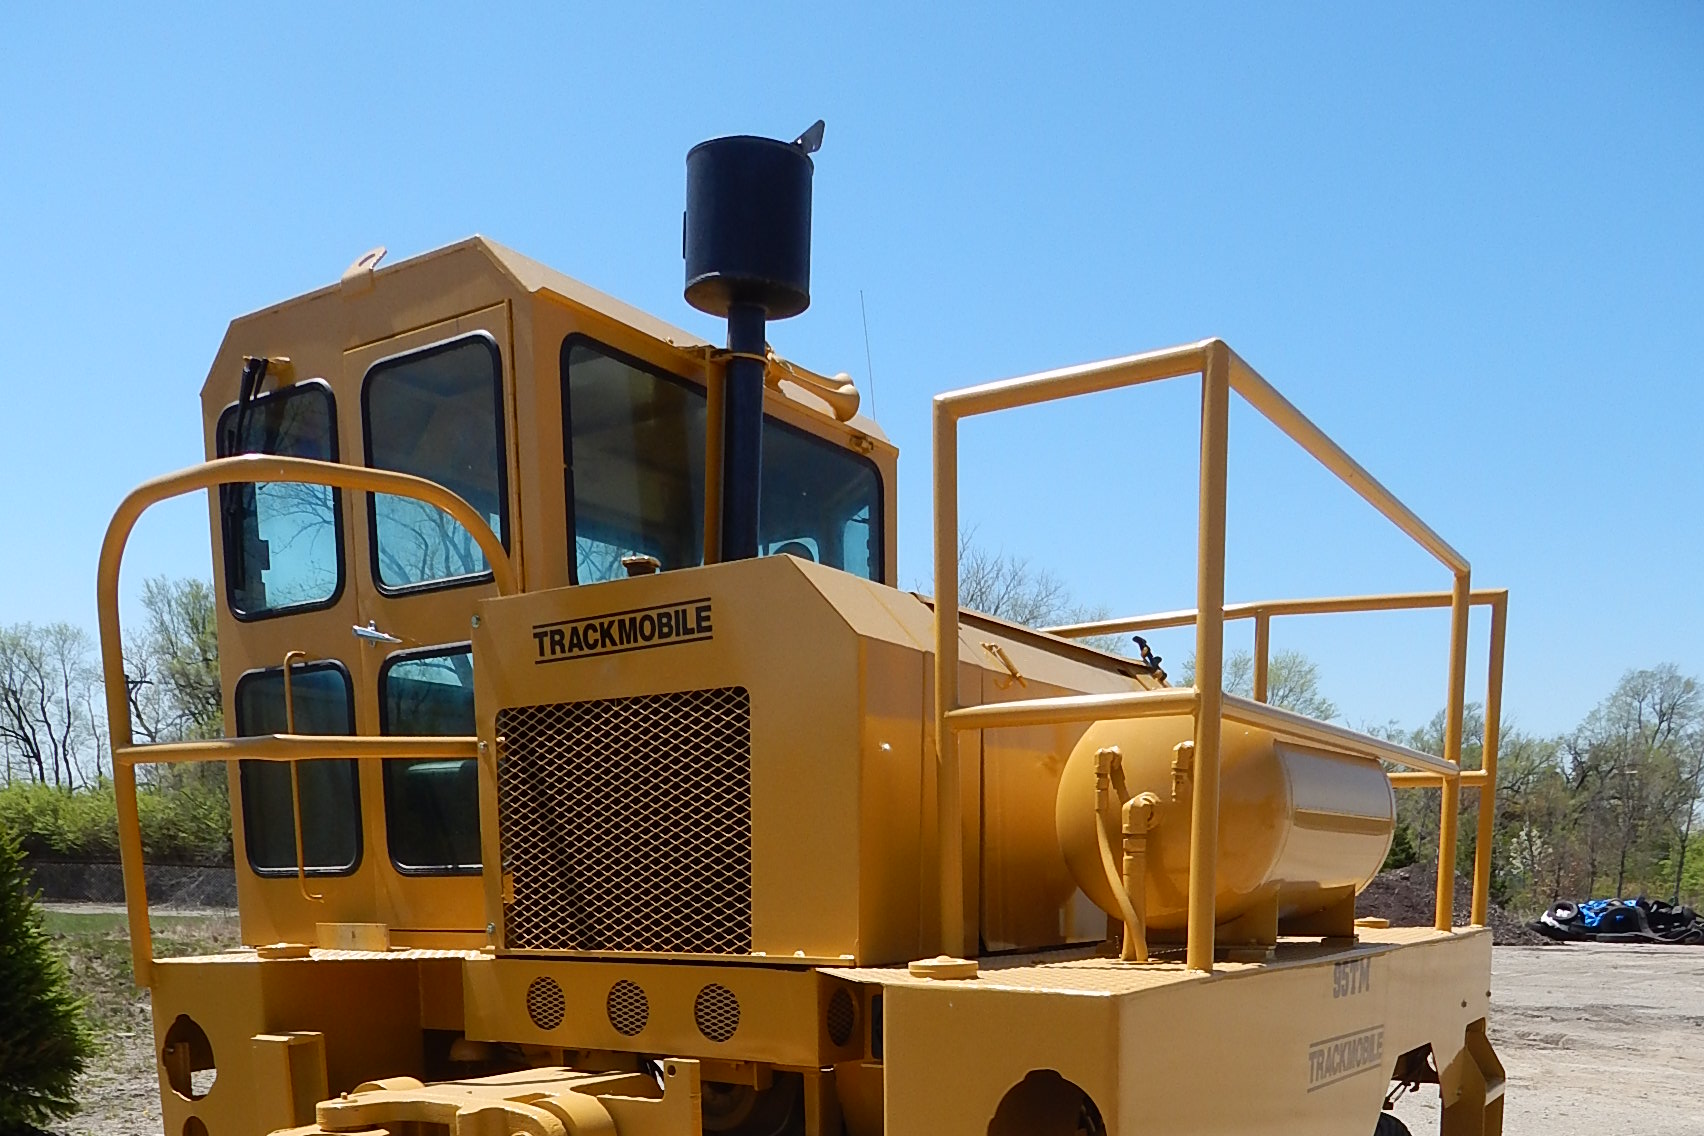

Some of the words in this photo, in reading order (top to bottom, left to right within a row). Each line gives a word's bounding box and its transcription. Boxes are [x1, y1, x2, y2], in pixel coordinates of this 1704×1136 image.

[533, 605, 712, 656] TRACKMOBILE
[1333, 957, 1371, 999] 95TM
[1308, 1031, 1385, 1084] TRACKMOBILE
